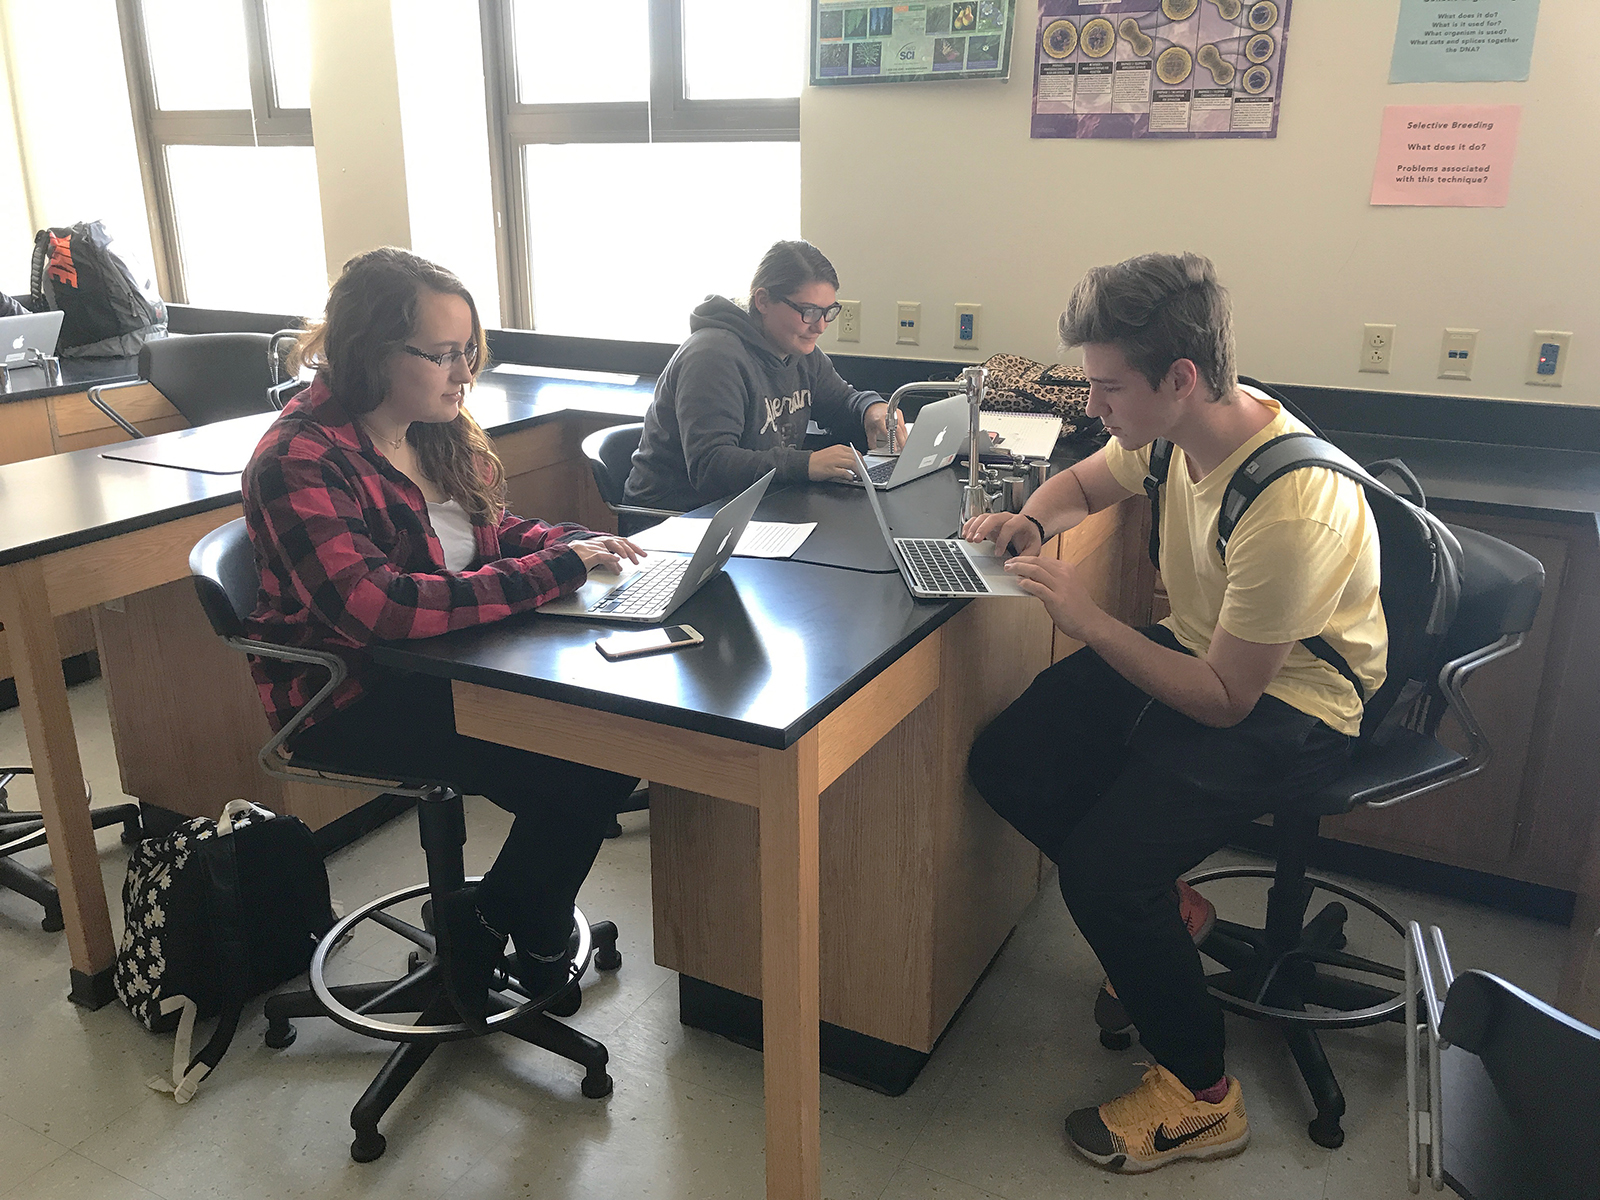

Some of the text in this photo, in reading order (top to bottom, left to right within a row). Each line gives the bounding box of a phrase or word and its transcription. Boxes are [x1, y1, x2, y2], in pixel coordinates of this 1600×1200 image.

[900, 51, 915, 60] SCI
[1451, 121, 1494, 130] Breeding
[1438, 176, 1488, 185] technique?
